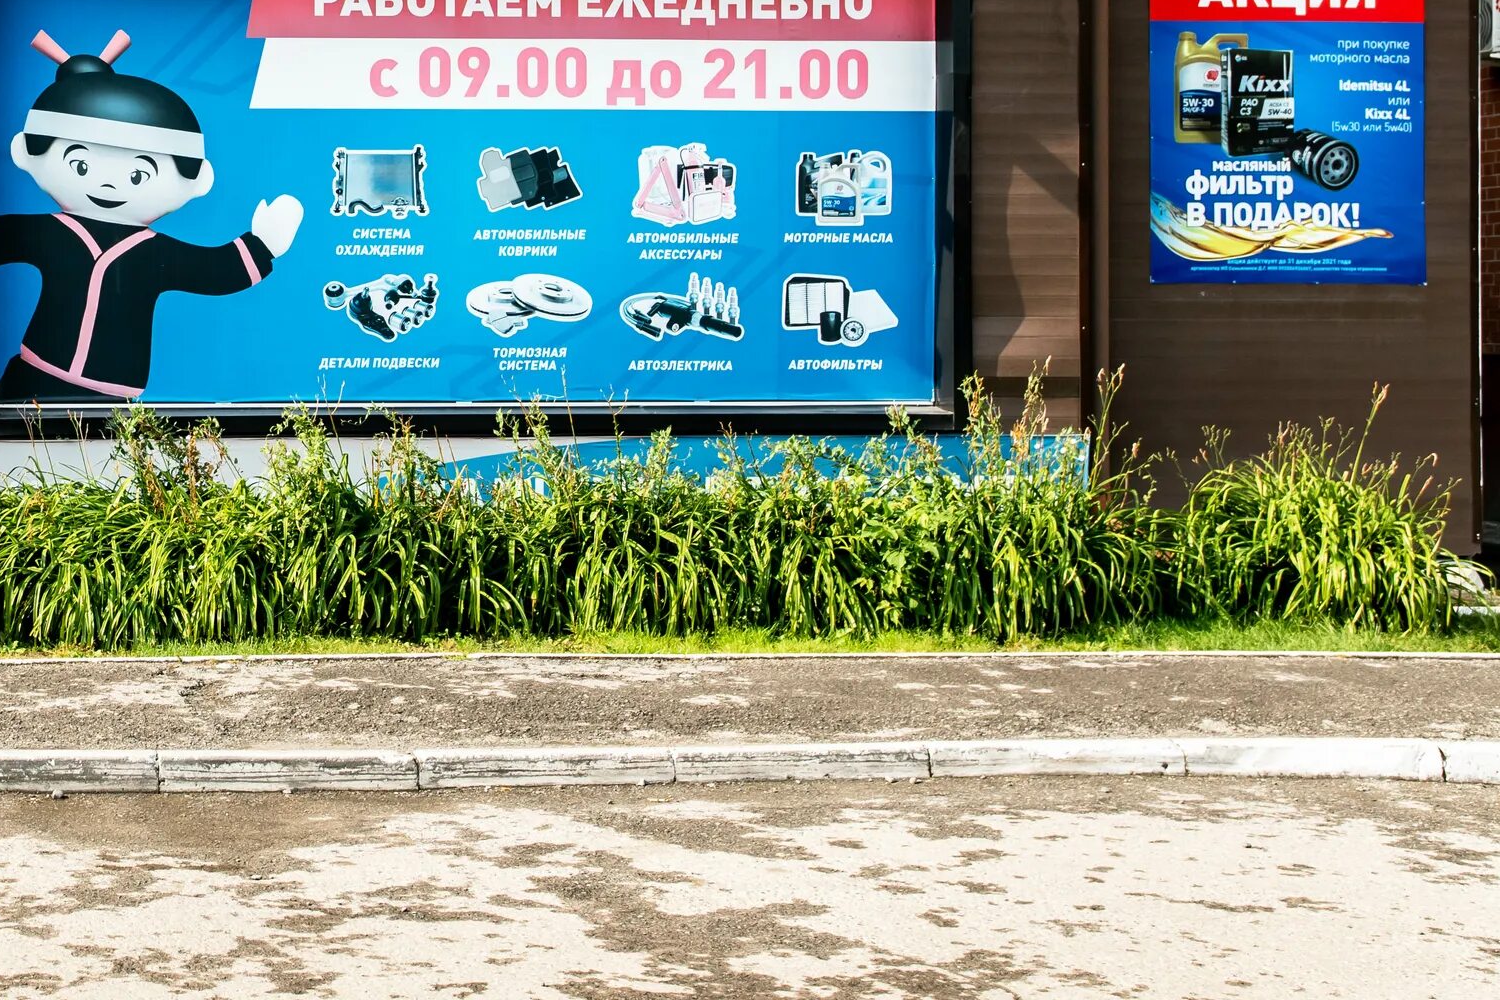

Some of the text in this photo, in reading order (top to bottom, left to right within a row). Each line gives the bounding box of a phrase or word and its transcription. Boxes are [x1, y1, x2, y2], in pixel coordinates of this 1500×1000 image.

[1337, 40, 1411, 53] при покупке
[1309, 53, 1411, 66] моторного масла
[370, 46, 869, 106] с 09.00 до 21.00
[1238, 75, 1292, 93] Kixx
[1338, 79, 1411, 92] Idemitsu 4L
[1182, 98, 1215, 108] 5W-30
[1388, 97, 1411, 106] или
[1240, 107, 1252, 116] C3
[1268, 108, 1292, 116] 5W-40
[1365, 108, 1411, 120] Kixx 4L
[1331, 121, 1412, 133] (5w30 или 5w40)
[1212, 157, 1292, 173] масляный
[1185, 170, 1294, 200] фильтр
[1186, 202, 1361, 232] В ПОДАРОК!
[352, 227, 412, 240] СИСТЕМА
[473, 228, 587, 241] АВТОМОБИЛЬНЫЕ
[627, 232, 740, 245] АВТОМОБИЛЬНЫЕ
[784, 232, 894, 244] МОТОРНЫЕ МАСЛА
[335, 244, 425, 257] ОХЛАЖДЕНИЯ
[498, 245, 558, 257] КОВРИКИ
[639, 249, 723, 261] АКСЕССУАРЫ
[492, 347, 568, 359] ТОРМОЗНАЯ
[319, 357, 440, 370] ДЕТАЛИ ПОДВЕСКИ
[499, 359, 557, 371] СИСТЕМА
[628, 359, 734, 372] АВТОЭЛЕКТРИКА
[787, 358, 884, 371] АВТОФИЛЬТРЫ
